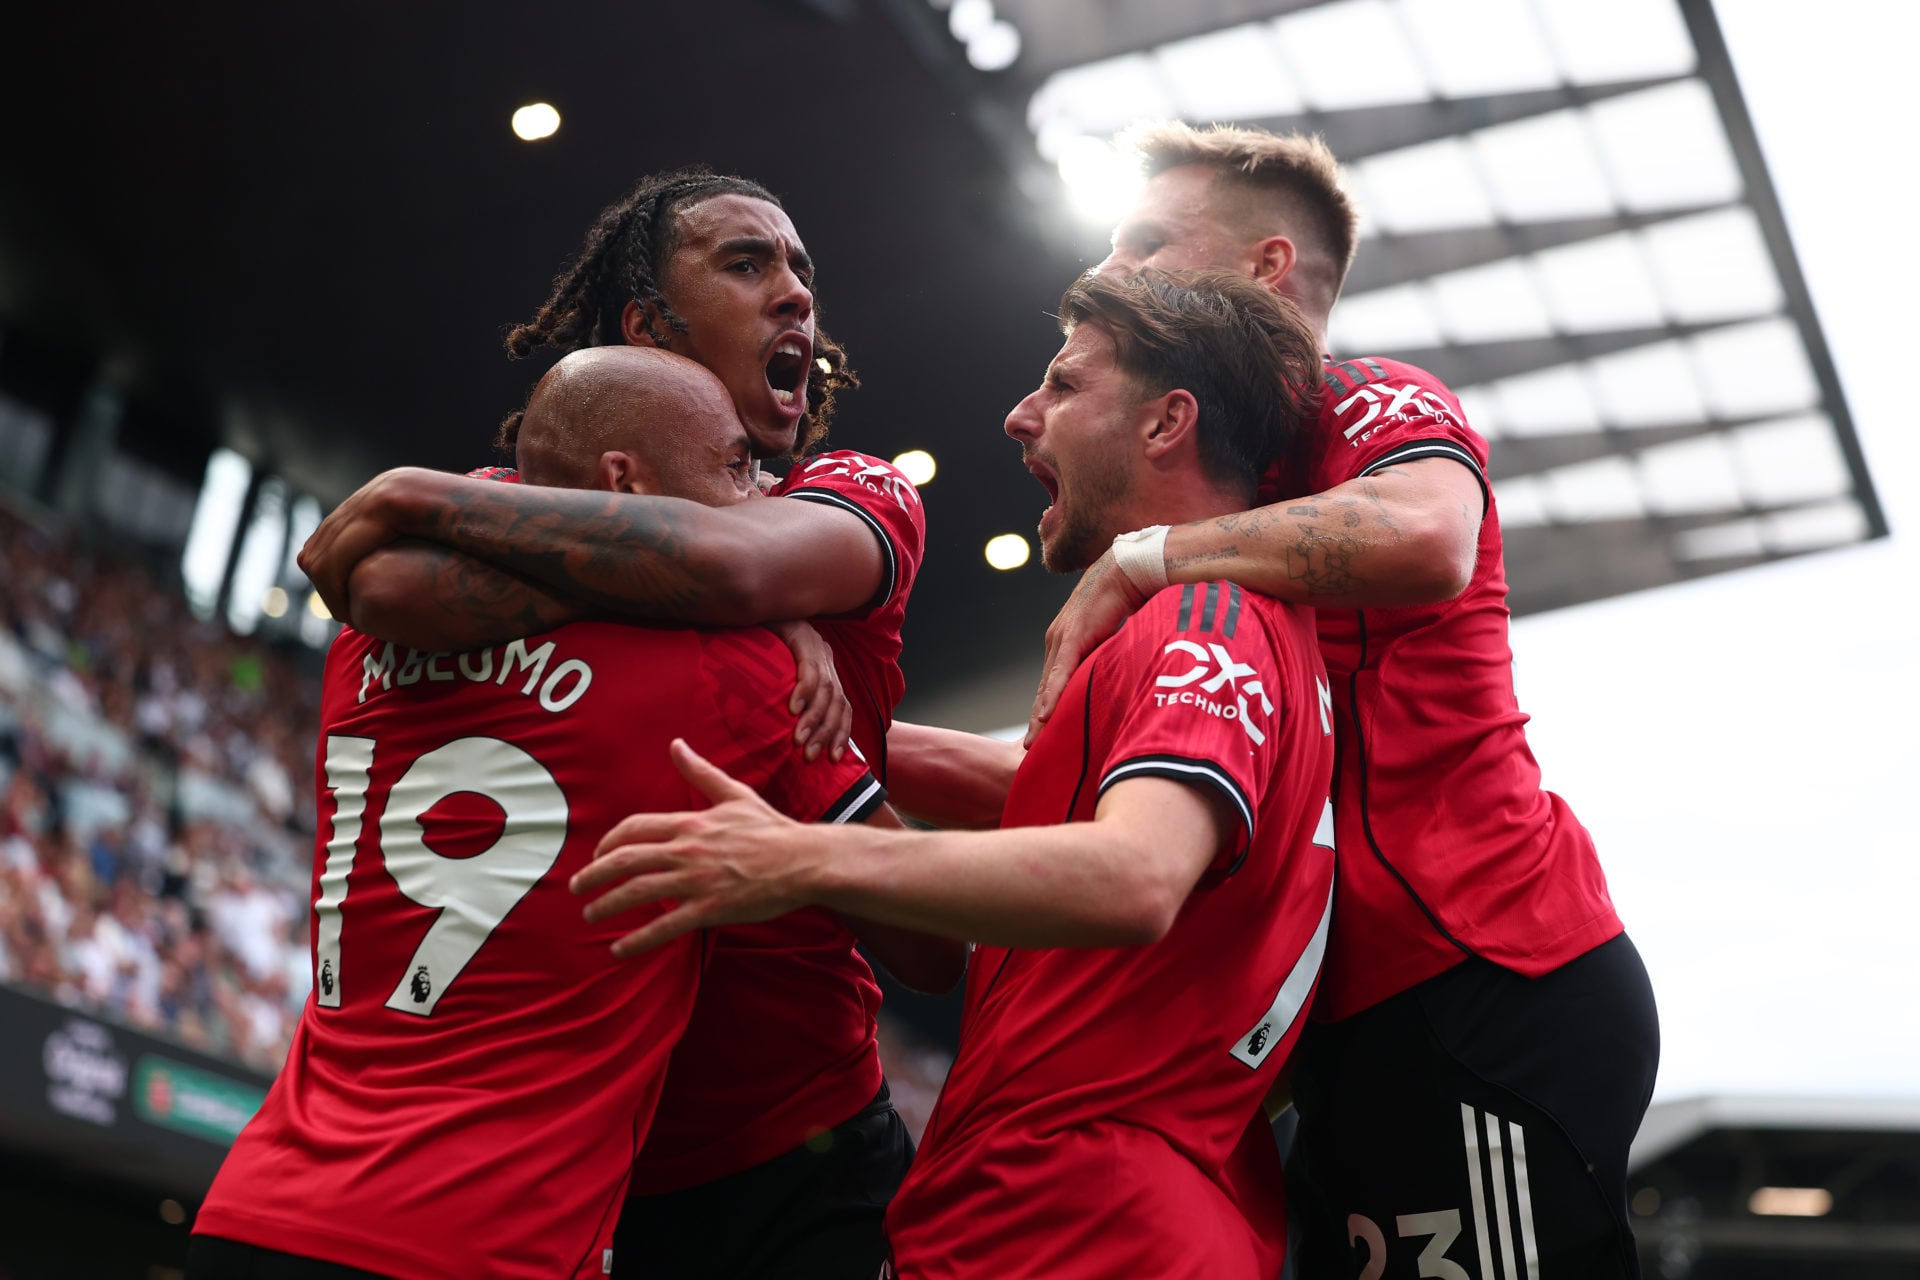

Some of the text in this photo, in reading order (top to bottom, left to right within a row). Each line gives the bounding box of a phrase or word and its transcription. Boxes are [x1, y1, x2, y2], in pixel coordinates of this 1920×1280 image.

[358, 638, 593, 713] MBEUMO
[1154, 691, 1238, 720] TECHNO
[1155, 640, 1274, 747] DXC
[315, 734, 569, 1017] 19
[1347, 1208, 1470, 1280] 23
